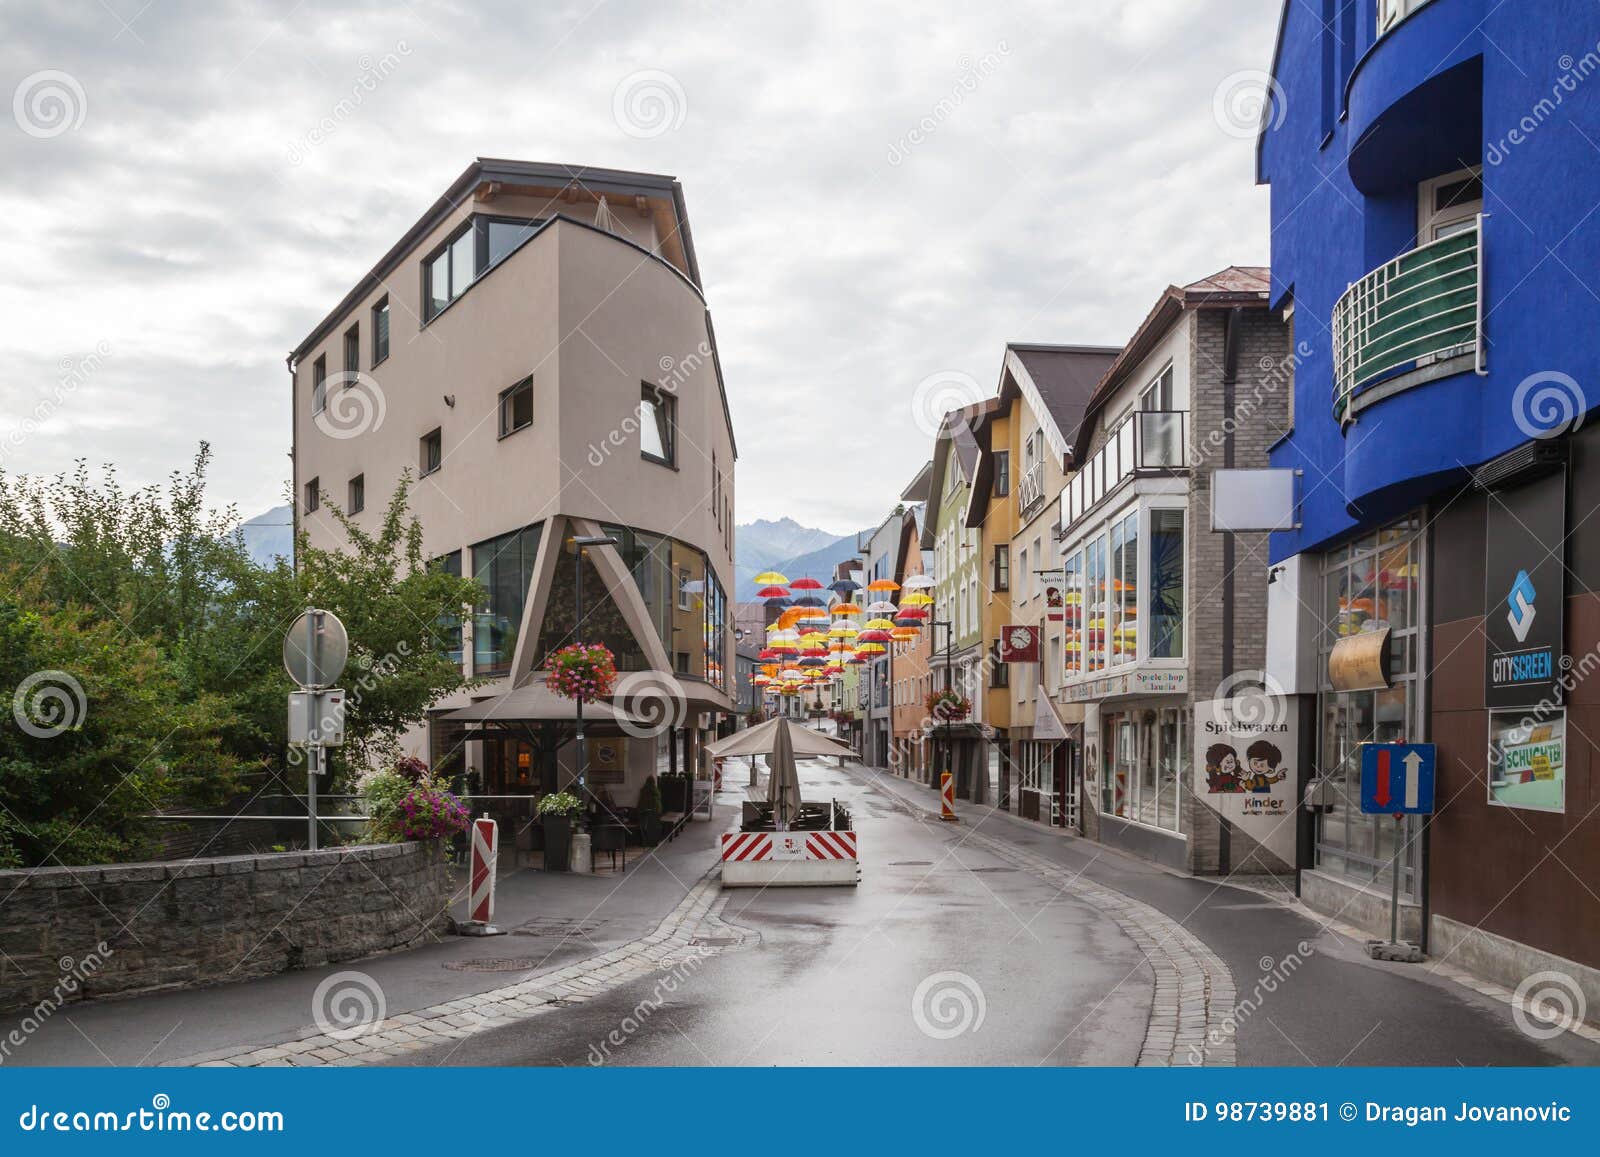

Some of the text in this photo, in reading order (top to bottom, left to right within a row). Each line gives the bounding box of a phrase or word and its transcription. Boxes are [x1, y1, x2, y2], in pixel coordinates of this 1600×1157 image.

[1492, 652, 1552, 683] CITYSCREEN
[1164, 673, 1183, 682] Shop
[1205, 720, 1289, 735] Spielwaren
[1244, 797, 1285, 809] Kinder
